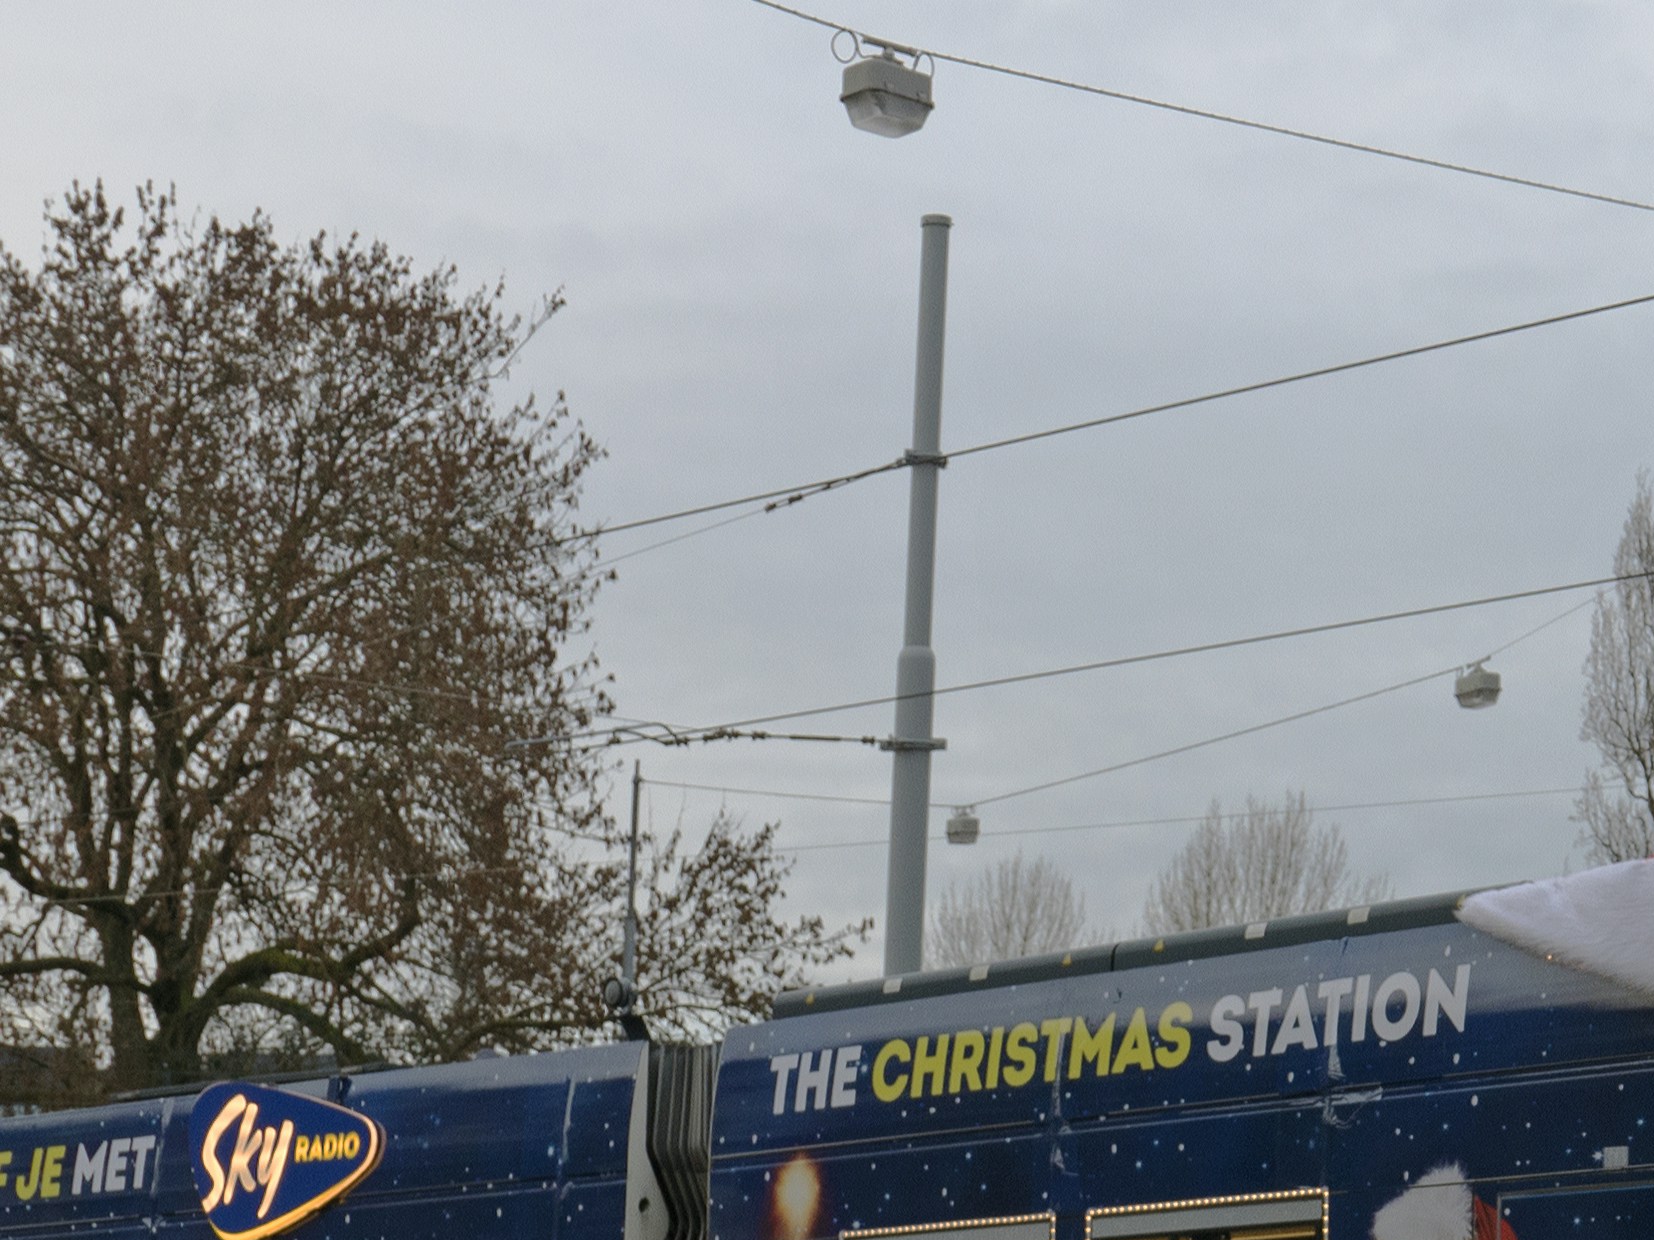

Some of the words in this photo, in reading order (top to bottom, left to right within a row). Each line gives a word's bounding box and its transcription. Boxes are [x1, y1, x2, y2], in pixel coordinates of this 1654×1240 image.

[768, 1045, 863, 1116] THE
[870, 1001, 1194, 1103] CHRISTMAS
[1205, 964, 1472, 1063] STATION
[15, 1145, 67, 1201] JE
[71, 1135, 157, 1195] MET
[201, 1093, 294, 1219] Sky
[294, 1131, 361, 1163] RADIO
